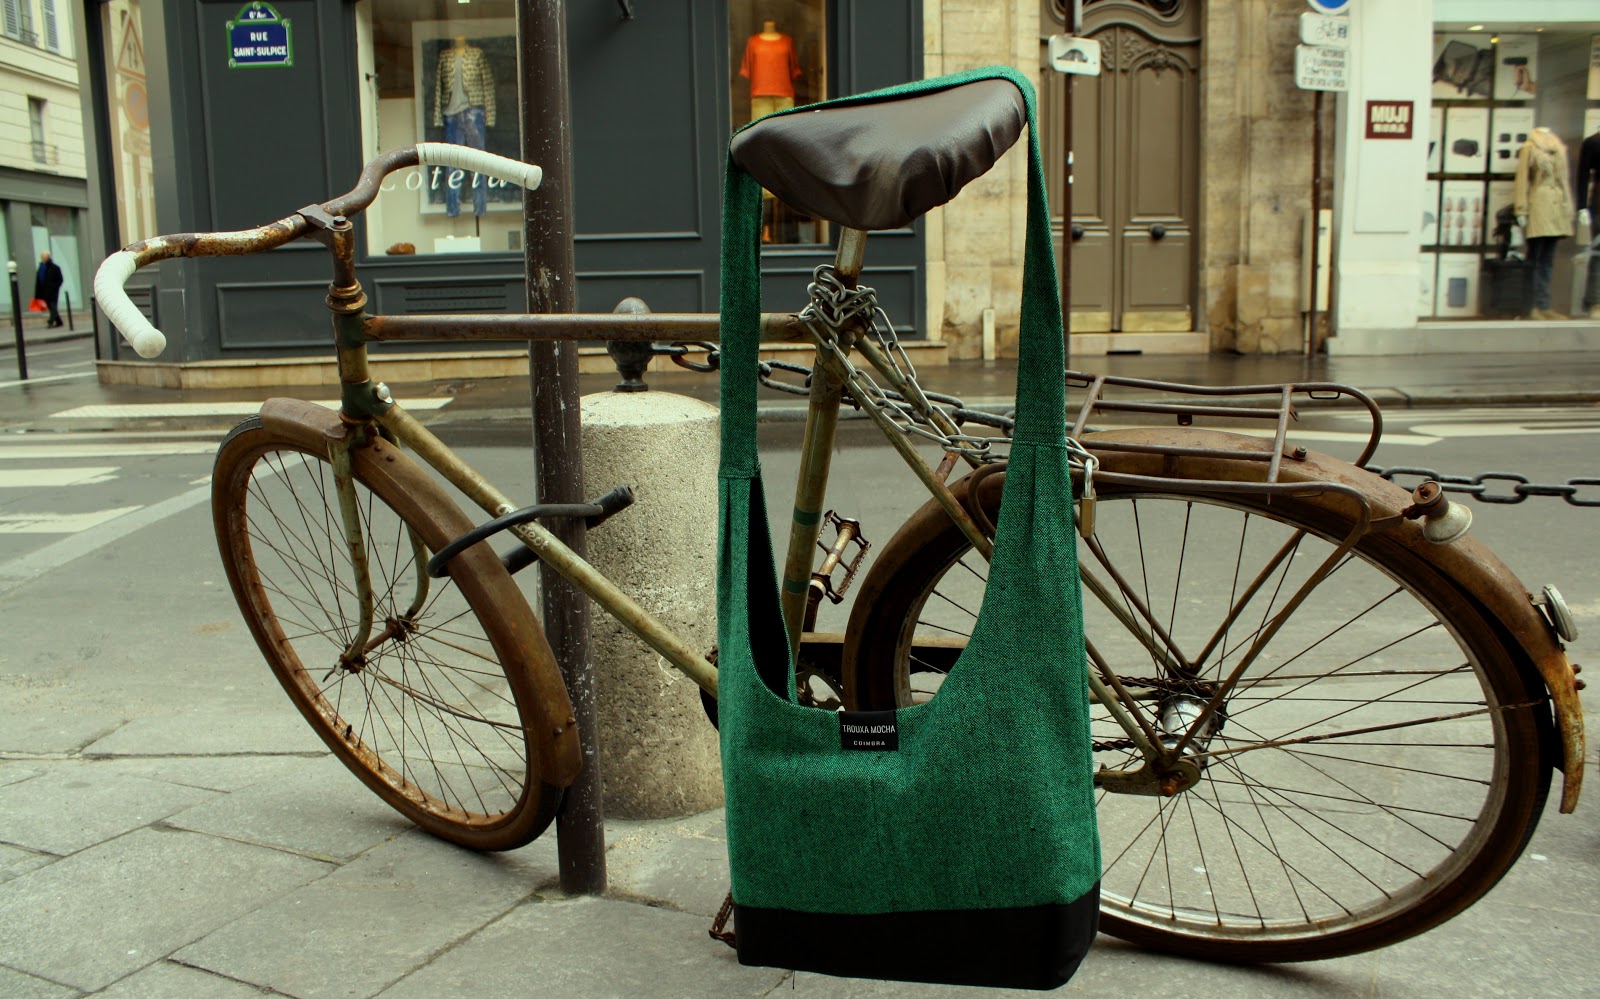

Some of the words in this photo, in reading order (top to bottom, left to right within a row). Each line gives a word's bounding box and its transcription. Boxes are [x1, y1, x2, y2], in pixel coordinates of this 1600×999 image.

[250, 32, 268, 41] RUE
[233, 46, 286, 57] SAINT-SULPICE
[1371, 105, 1410, 123] MUJI
[842, 724, 869, 734] TROUXA
[870, 724, 896, 734] MOCHA
